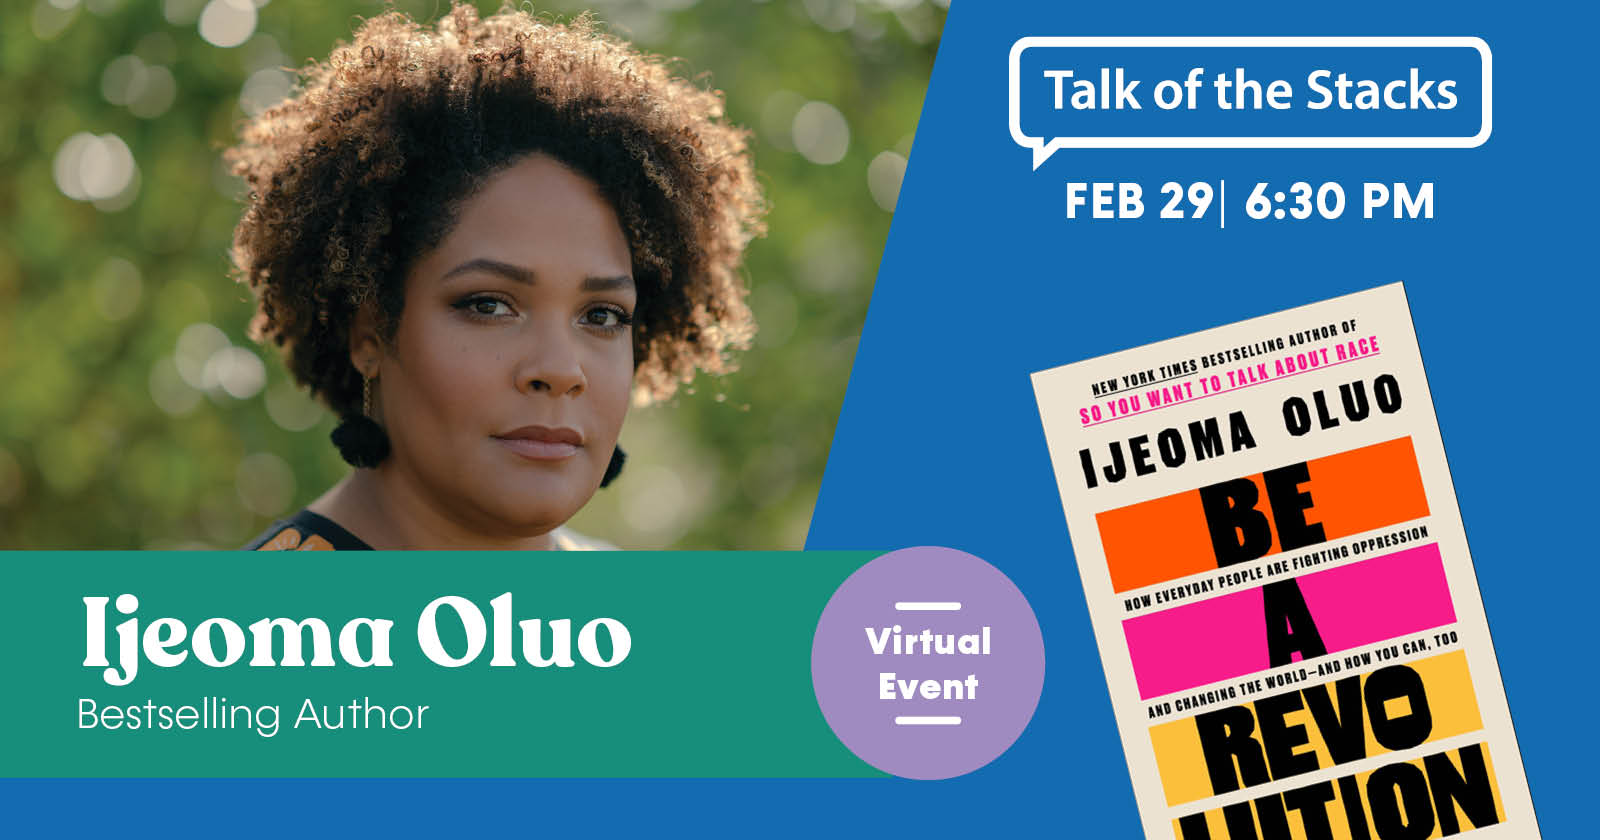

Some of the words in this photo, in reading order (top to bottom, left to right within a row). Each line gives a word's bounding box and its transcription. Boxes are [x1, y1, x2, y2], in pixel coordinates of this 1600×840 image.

[1078, 404, 1102, 425] SO
[1106, 394, 1141, 418] YOU
[1145, 381, 1193, 408] WANT
[1198, 374, 1222, 395] TO
[1225, 362, 1270, 388] TALK
[1274, 347, 1329, 377] ABOUT
[1334, 334, 1380, 361] RACE
[1091, 378, 1118, 397] NEW
[1121, 369, 1156, 388] YORK
[1158, 358, 1198, 379] TIMES
[1200, 337, 1285, 369] BESTSELLING
[1288, 323, 1338, 347] AUTHOR
[1341, 318, 1357, 334] OF
[1079, 410, 1257, 489] IJEOMA
[1281, 373, 1403, 437] OLUO
[1198, 460, 1327, 569] BE
[1123, 593, 1152, 612] HOW
[1154, 578, 1214, 604] EVERYDAY
[1217, 566, 1263, 589] PEOPLE
[1266, 559, 1290, 577] ARE
[1291, 544, 1349, 570] FIGHTING
[1351, 525, 1429, 555] OPPRESSION
[1261, 576, 1329, 669] A
[1147, 702, 1172, 719] AND
[1174, 685, 1237, 712] CHANGING
[1238, 679, 1263, 696] THE
[1343, 651, 1371, 670] HOW
[1374, 645, 1399, 662] YOU
[1402, 638, 1432, 655] CAN,
[1433, 630, 1458, 648] TOO
[1193, 663, 1433, 796] REVO
